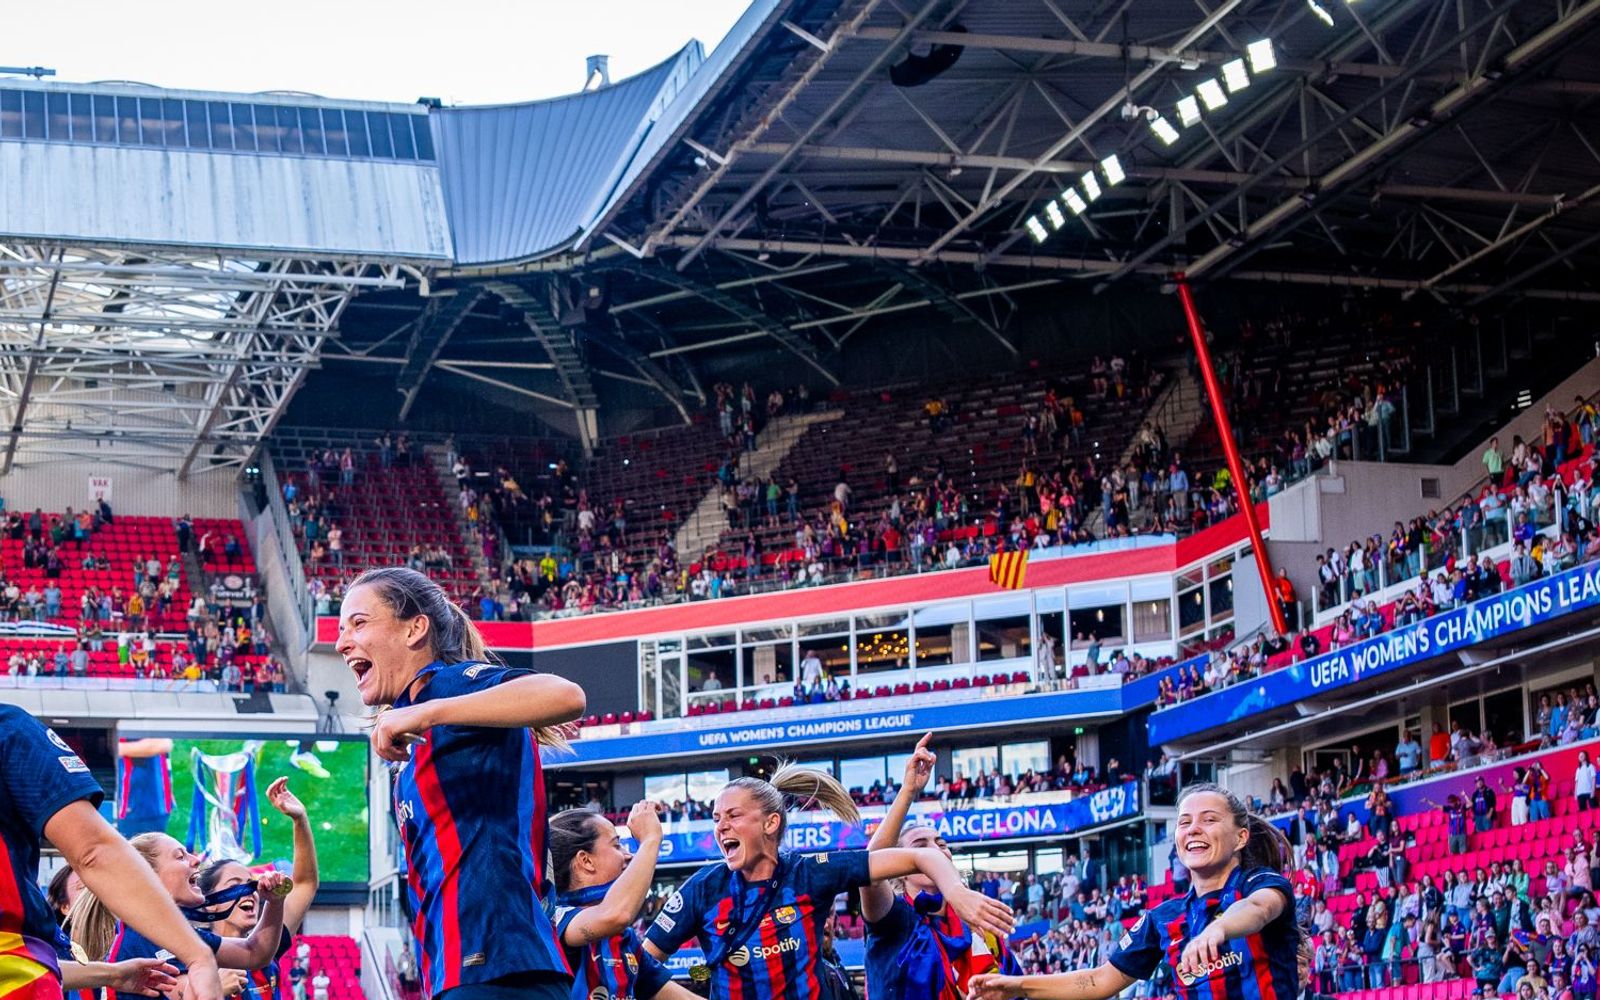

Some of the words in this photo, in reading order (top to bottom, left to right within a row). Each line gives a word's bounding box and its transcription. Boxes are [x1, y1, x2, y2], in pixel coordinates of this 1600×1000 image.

[92, 479, 109, 487] VAK
[1311, 657, 1349, 687] UEFA
[1351, 627, 1430, 673] WOMEN'S
[1434, 586, 1552, 647] CHAMPIONS
[1558, 571, 1600, 608] LEA
[699, 732, 728, 747] UEFA
[731, 727, 785, 743] WOMEN'S
[787, 718, 862, 738] CHAMPIONS
[866, 714, 913, 732] LEAGUE
[752, 938, 801, 959] Spotify
